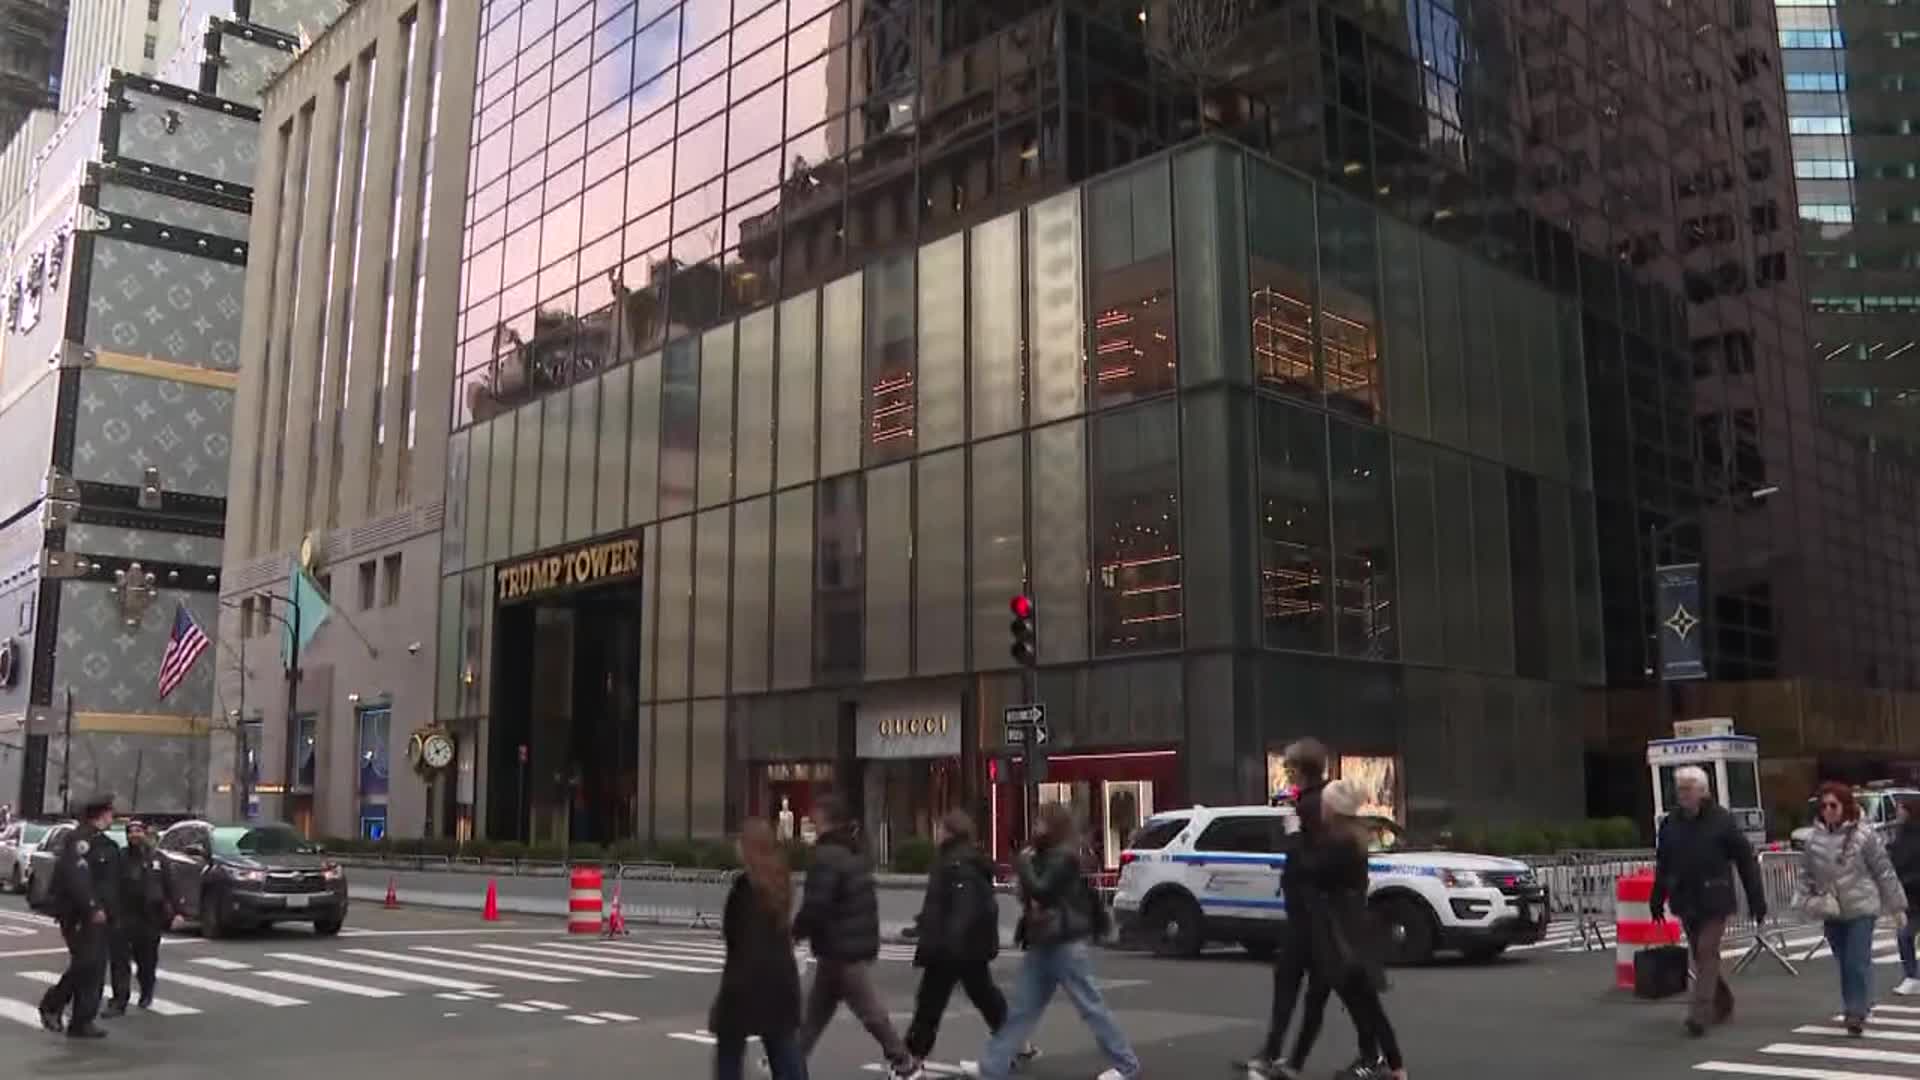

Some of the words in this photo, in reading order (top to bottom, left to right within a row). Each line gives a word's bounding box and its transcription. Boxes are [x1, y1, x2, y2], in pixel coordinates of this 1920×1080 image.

[498, 556, 562, 599] TRUMP
[563, 539, 640, 584] TOWER
[879, 714, 948, 737] GUCCI
